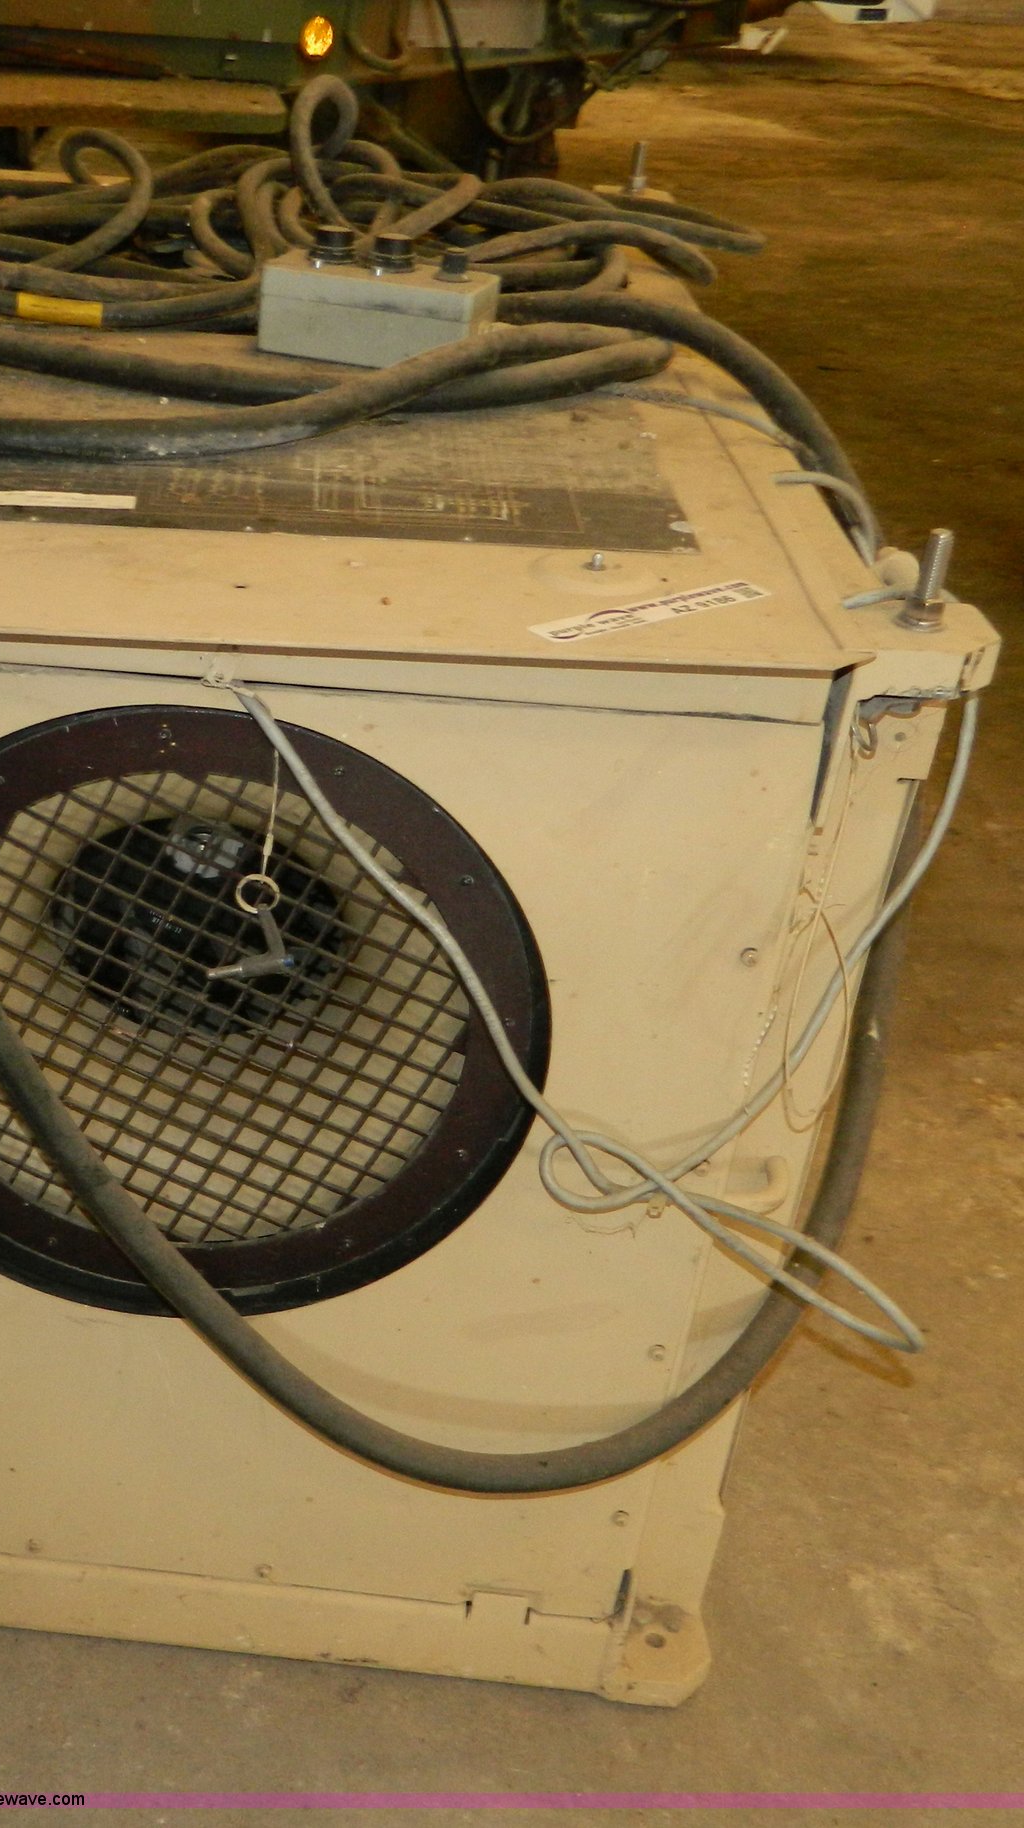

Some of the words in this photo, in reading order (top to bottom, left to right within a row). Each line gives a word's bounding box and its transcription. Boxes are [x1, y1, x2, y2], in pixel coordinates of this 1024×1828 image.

[670, 604, 697, 615] AZ
[548, 621, 595, 638] purple
[598, 613, 635, 626] wave
